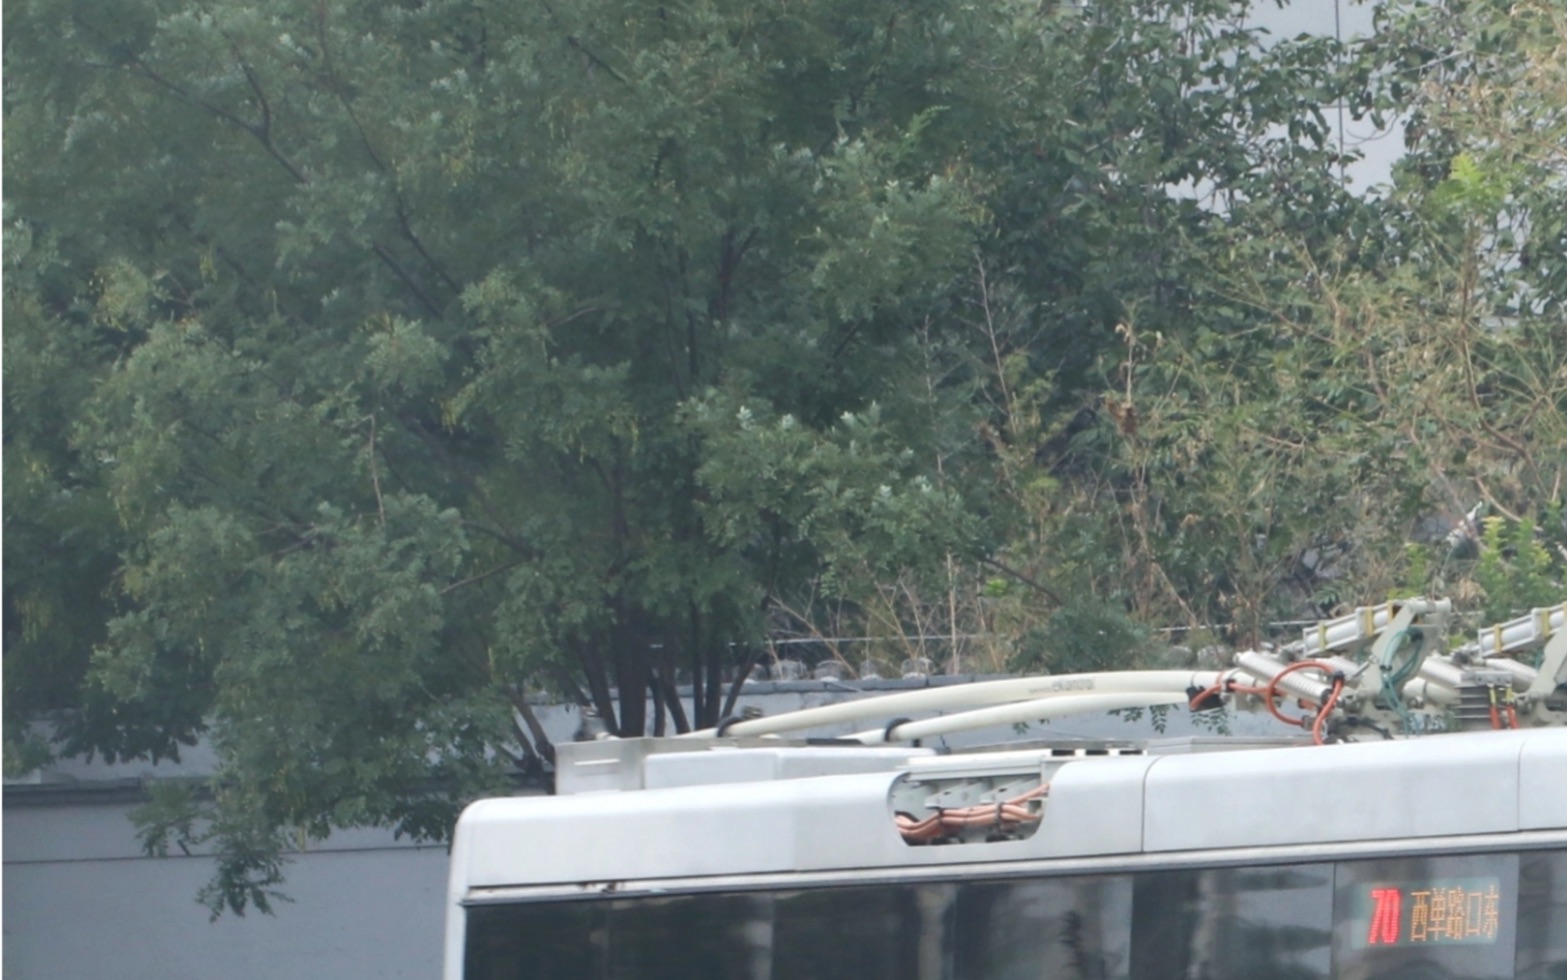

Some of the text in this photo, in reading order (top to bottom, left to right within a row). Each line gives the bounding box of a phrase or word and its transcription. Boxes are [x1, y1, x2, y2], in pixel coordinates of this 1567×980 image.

[1368, 884, 1499, 945] 70 西单路口东
